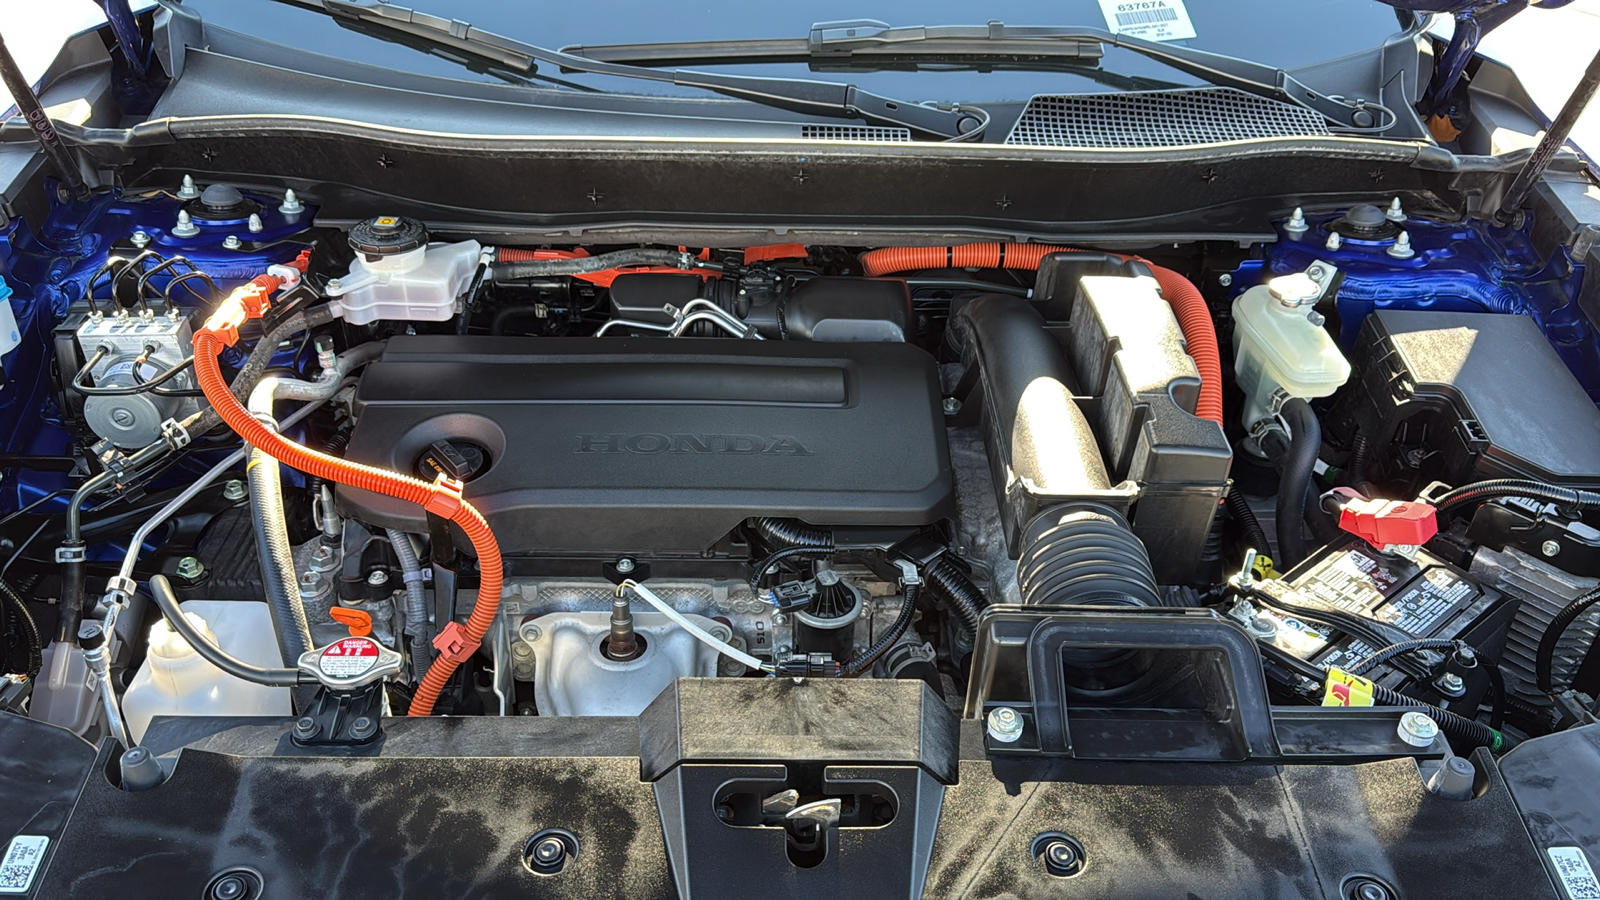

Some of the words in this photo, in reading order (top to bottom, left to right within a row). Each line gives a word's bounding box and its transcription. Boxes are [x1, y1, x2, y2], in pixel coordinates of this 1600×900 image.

[1117, 1, 1166, 11] 63767A
[573, 432, 815, 456] HONDA
[755, 621, 765, 644] 510
